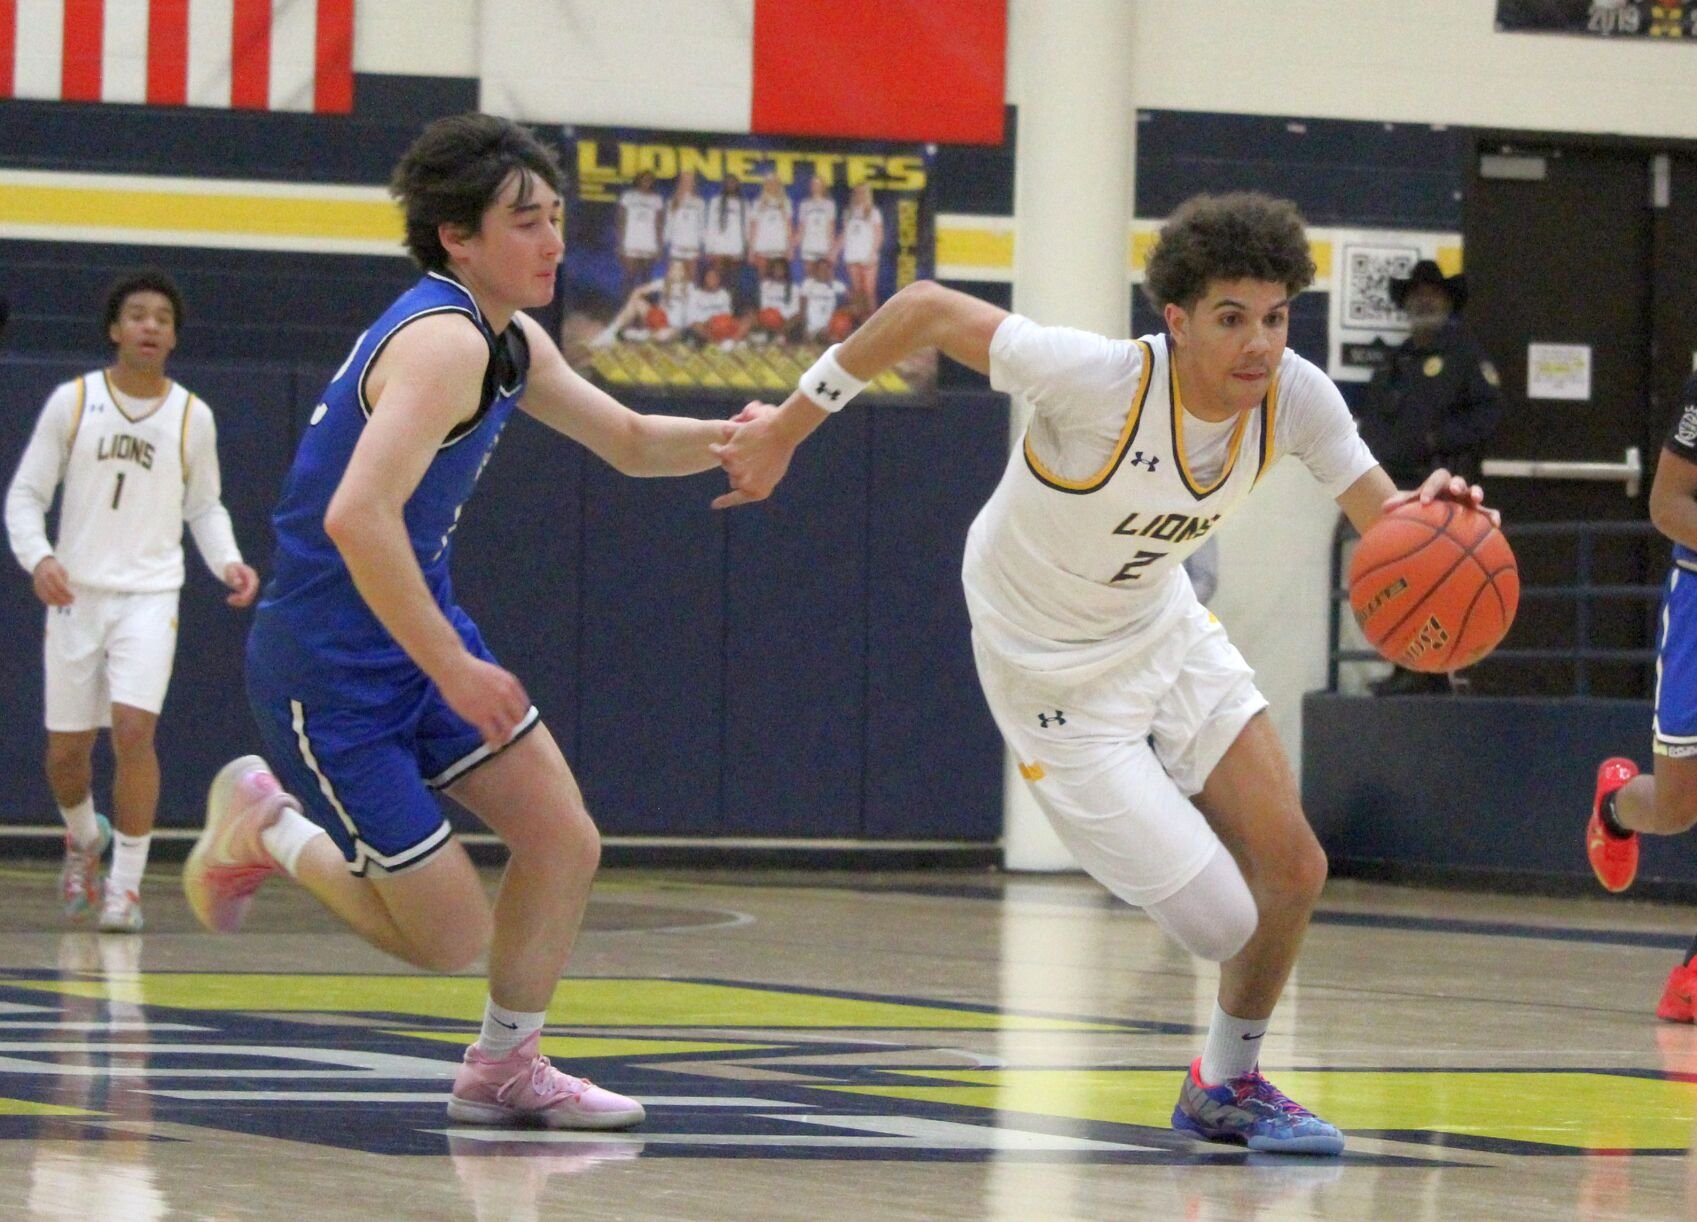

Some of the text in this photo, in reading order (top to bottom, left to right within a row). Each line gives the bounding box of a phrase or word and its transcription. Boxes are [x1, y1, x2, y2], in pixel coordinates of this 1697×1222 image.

[577, 139, 927, 191] LIONETTES
[97, 434, 155, 471] LIONS
[112, 473, 126, 510] 1
[1110, 550, 1169, 584] 2
